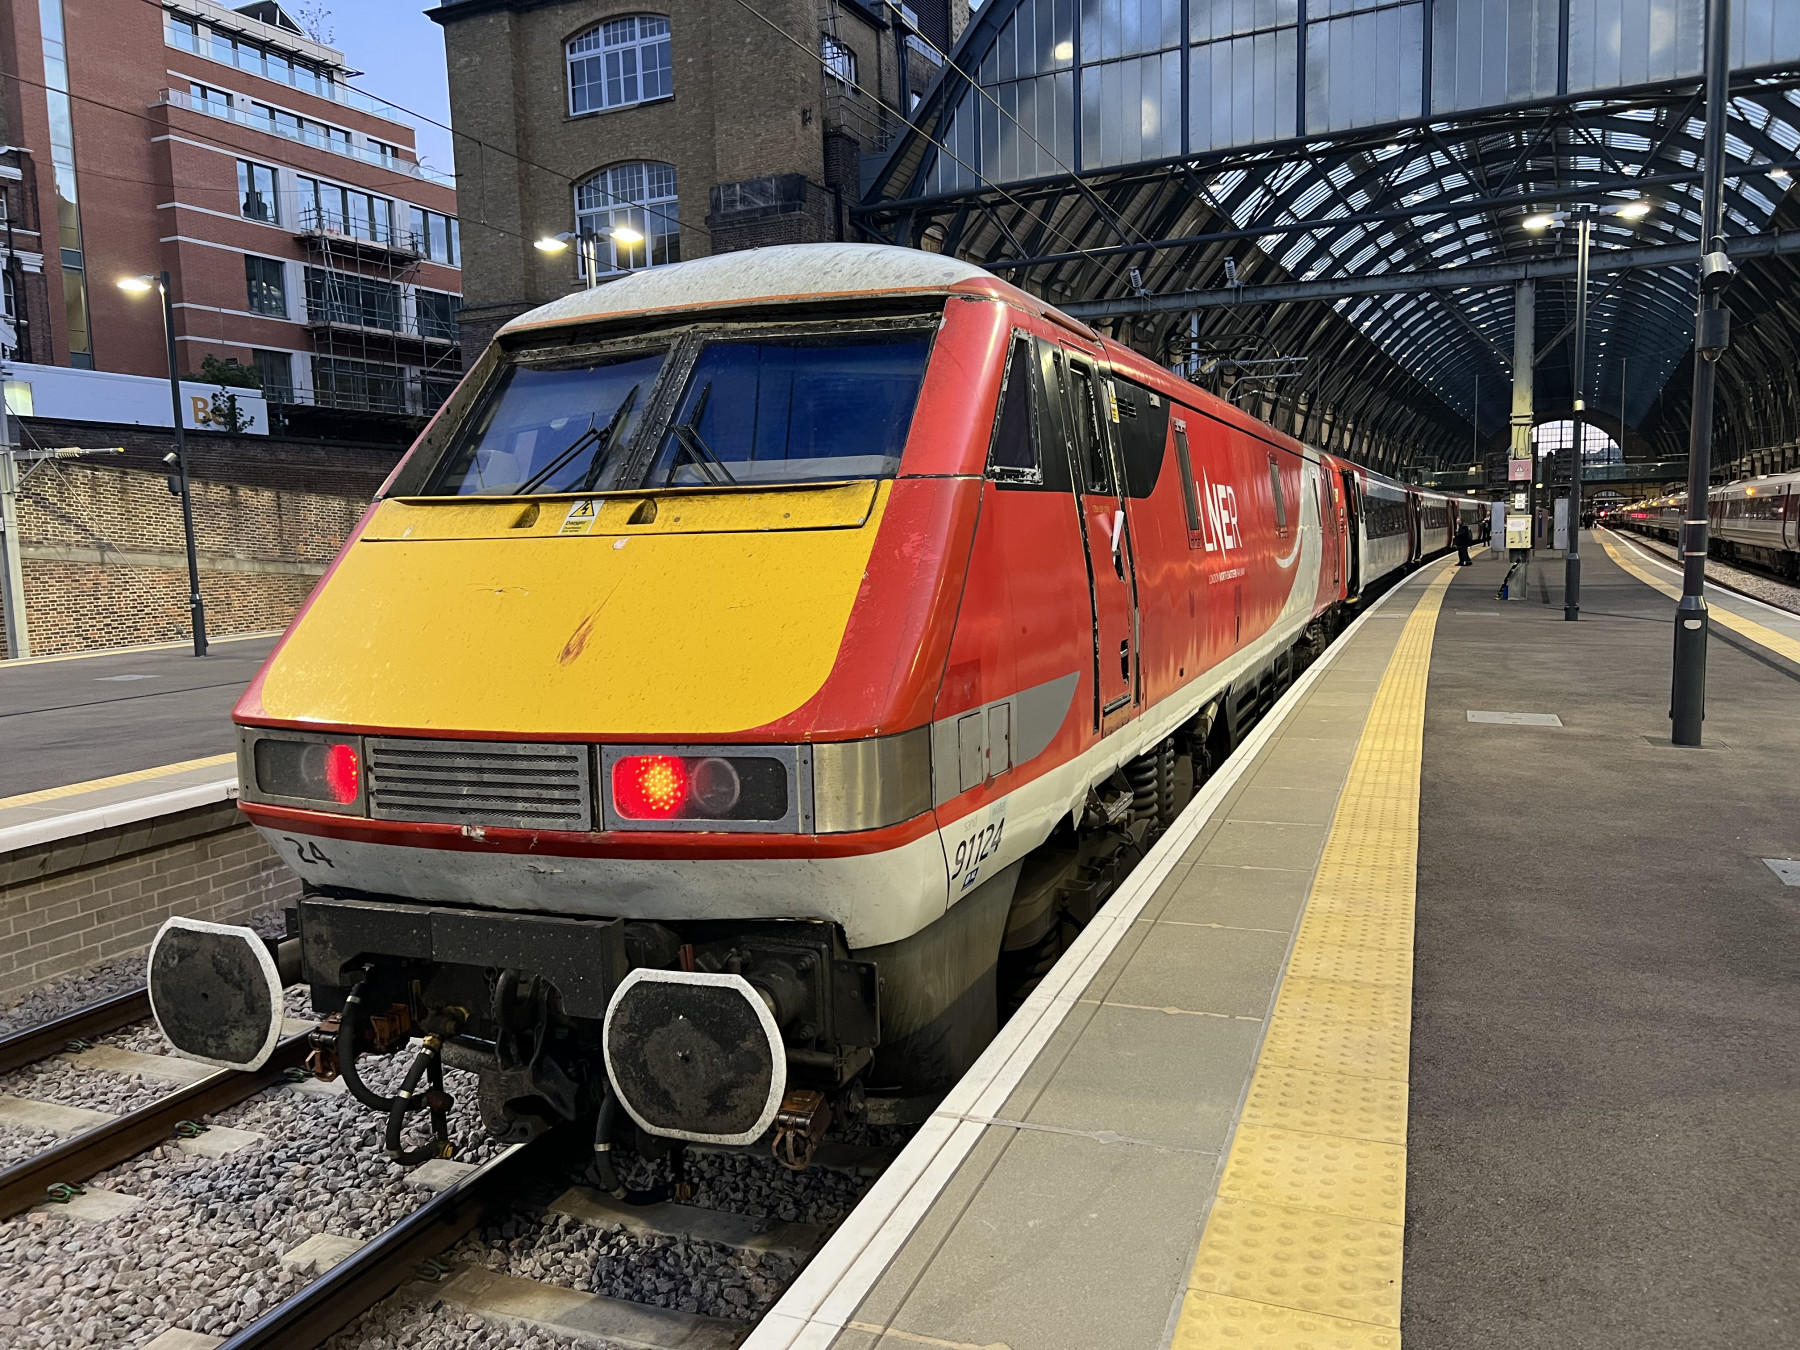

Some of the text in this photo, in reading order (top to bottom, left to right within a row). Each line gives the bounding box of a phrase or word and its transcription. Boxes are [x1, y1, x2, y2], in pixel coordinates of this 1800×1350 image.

[1195, 466, 1242, 564] LNER
[964, 814, 978, 832] sand
[282, 836, 336, 869] 24
[951, 817, 1005, 880] 91124
